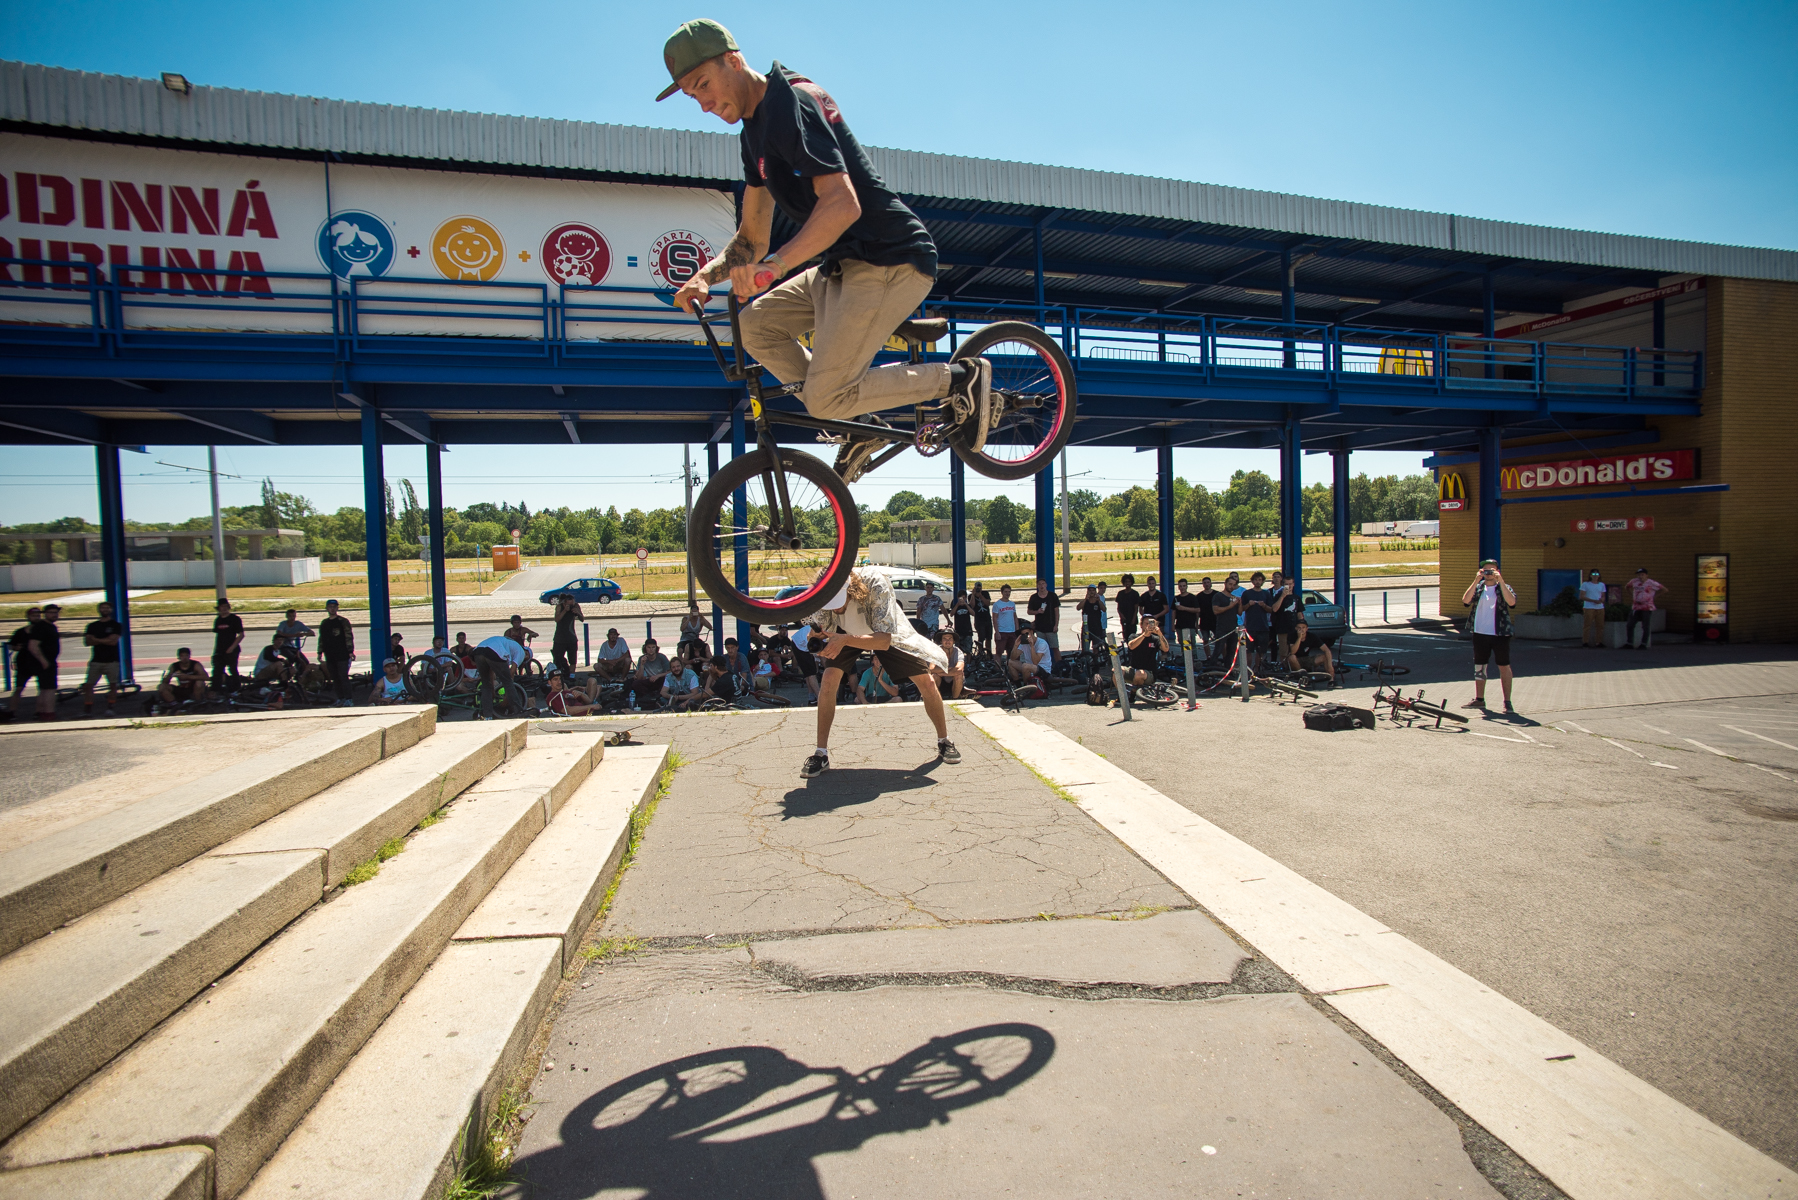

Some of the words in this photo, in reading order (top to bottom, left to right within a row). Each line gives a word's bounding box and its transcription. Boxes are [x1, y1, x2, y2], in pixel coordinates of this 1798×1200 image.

[0, 171, 279, 239] DINNÁ
[652, 232, 692, 255] SPARTA
[698, 239, 715, 262] PRA
[0, 236, 275, 300] IBUNA
[650, 261, 661, 276] AC
[668, 244, 699, 282] S
[1501, 457, 1673, 489] McDonald's
